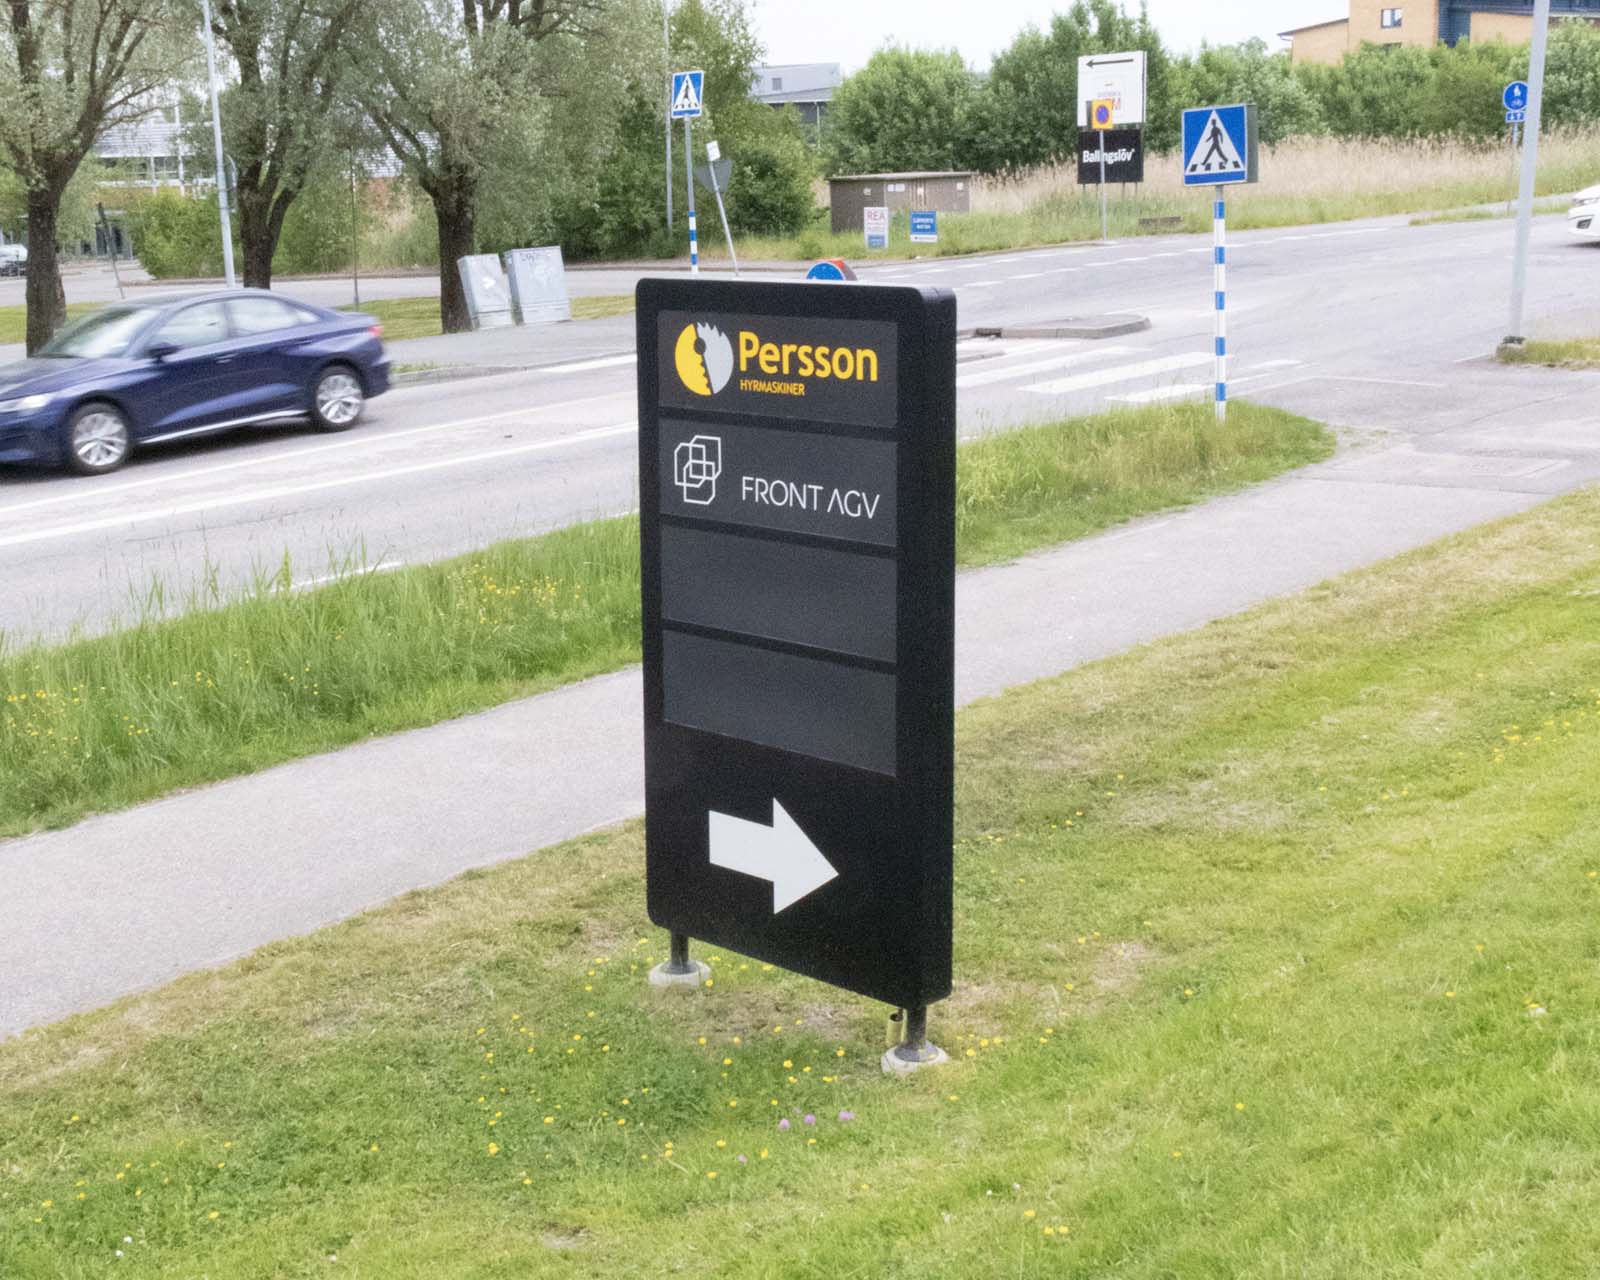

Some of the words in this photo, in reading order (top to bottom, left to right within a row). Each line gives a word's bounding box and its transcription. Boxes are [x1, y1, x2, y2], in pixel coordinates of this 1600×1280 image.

[1083, 149, 1133, 164] Ballngslöv
[867, 211, 885, 220] REA
[738, 330, 879, 382] Persson
[739, 379, 806, 397] HYRMASKINER
[741, 475, 825, 512] FRONT
[826, 488, 881, 520] AGV
